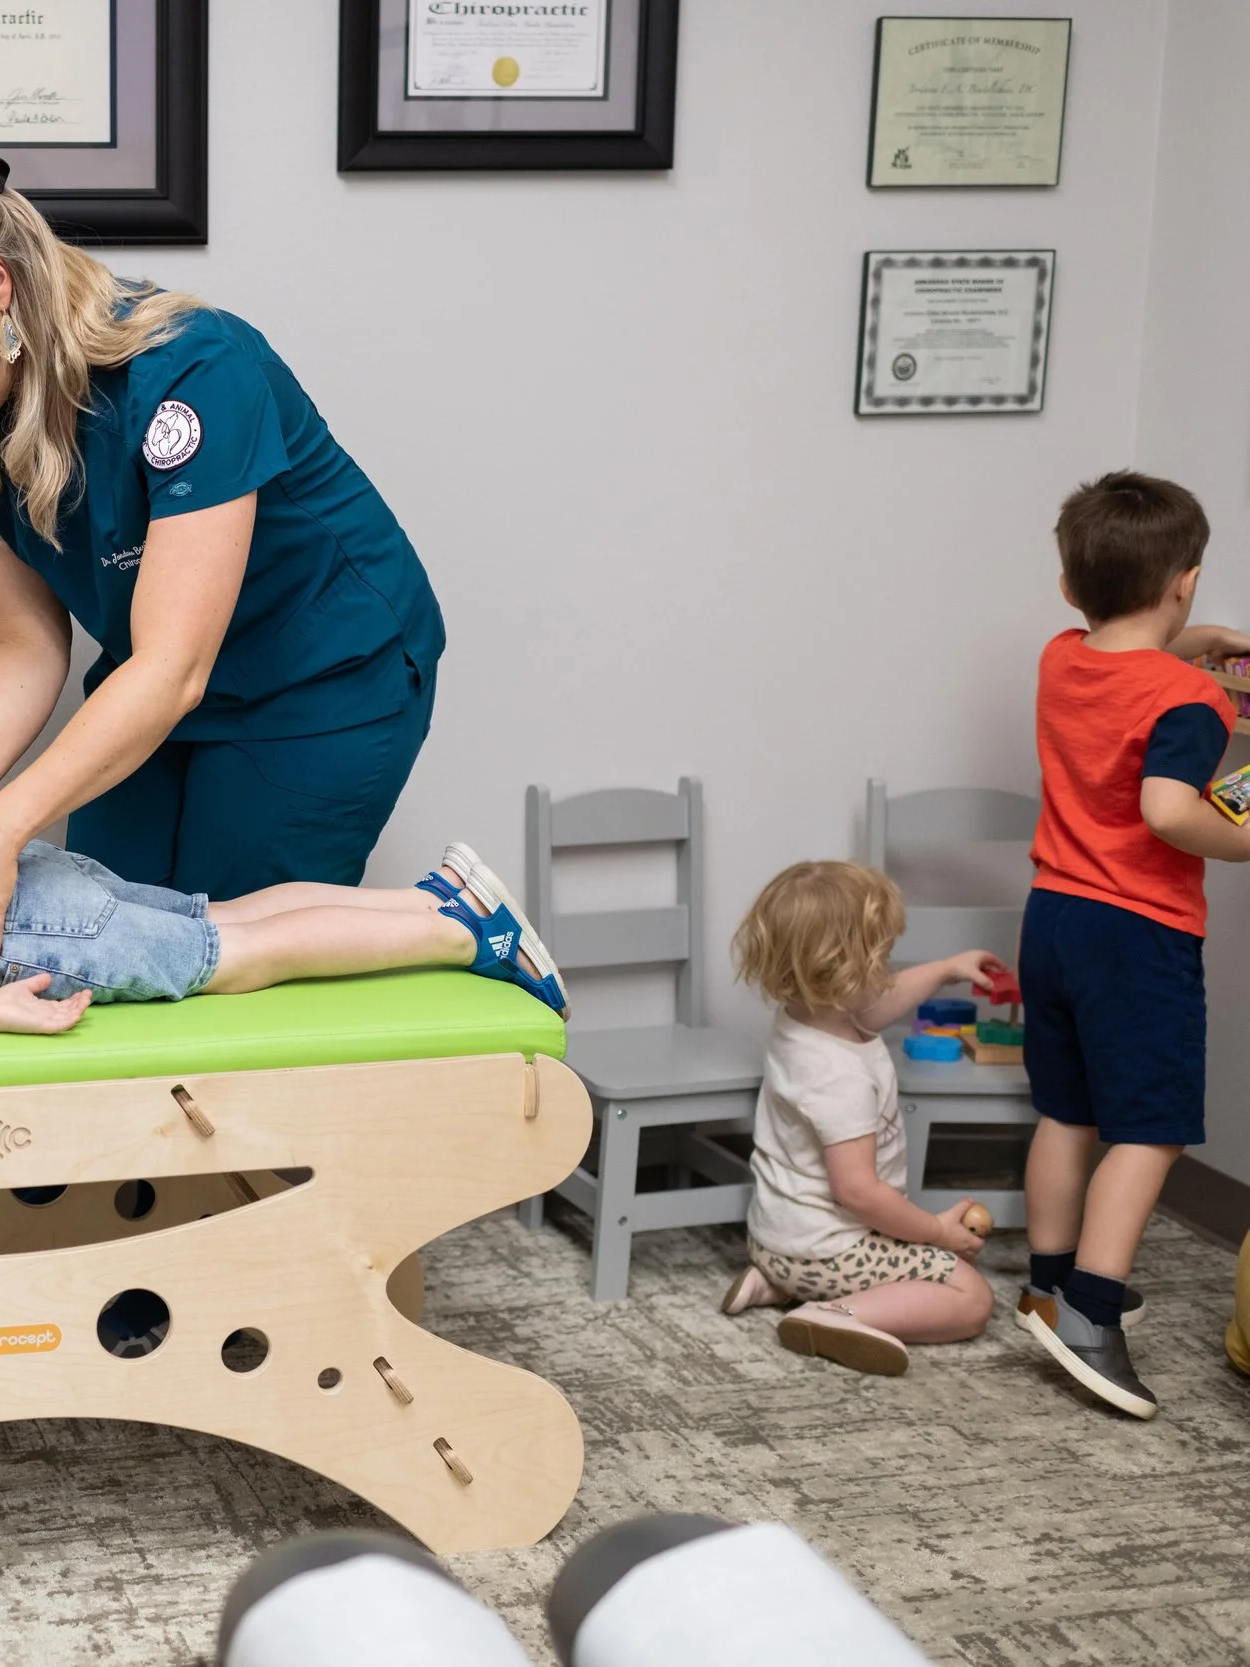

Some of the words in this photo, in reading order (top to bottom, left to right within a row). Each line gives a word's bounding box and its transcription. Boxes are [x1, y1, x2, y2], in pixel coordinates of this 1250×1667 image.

[428, 1, 588, 17] Chiropractic
[908, 37, 966, 55] CERTIFICATE
[983, 37, 1041, 55] MEMBERSHIP
[160, 403, 167, 411] &
[169, 403, 195, 424] ANIMAL
[151, 435, 198, 467] CHIROPRACTIC
